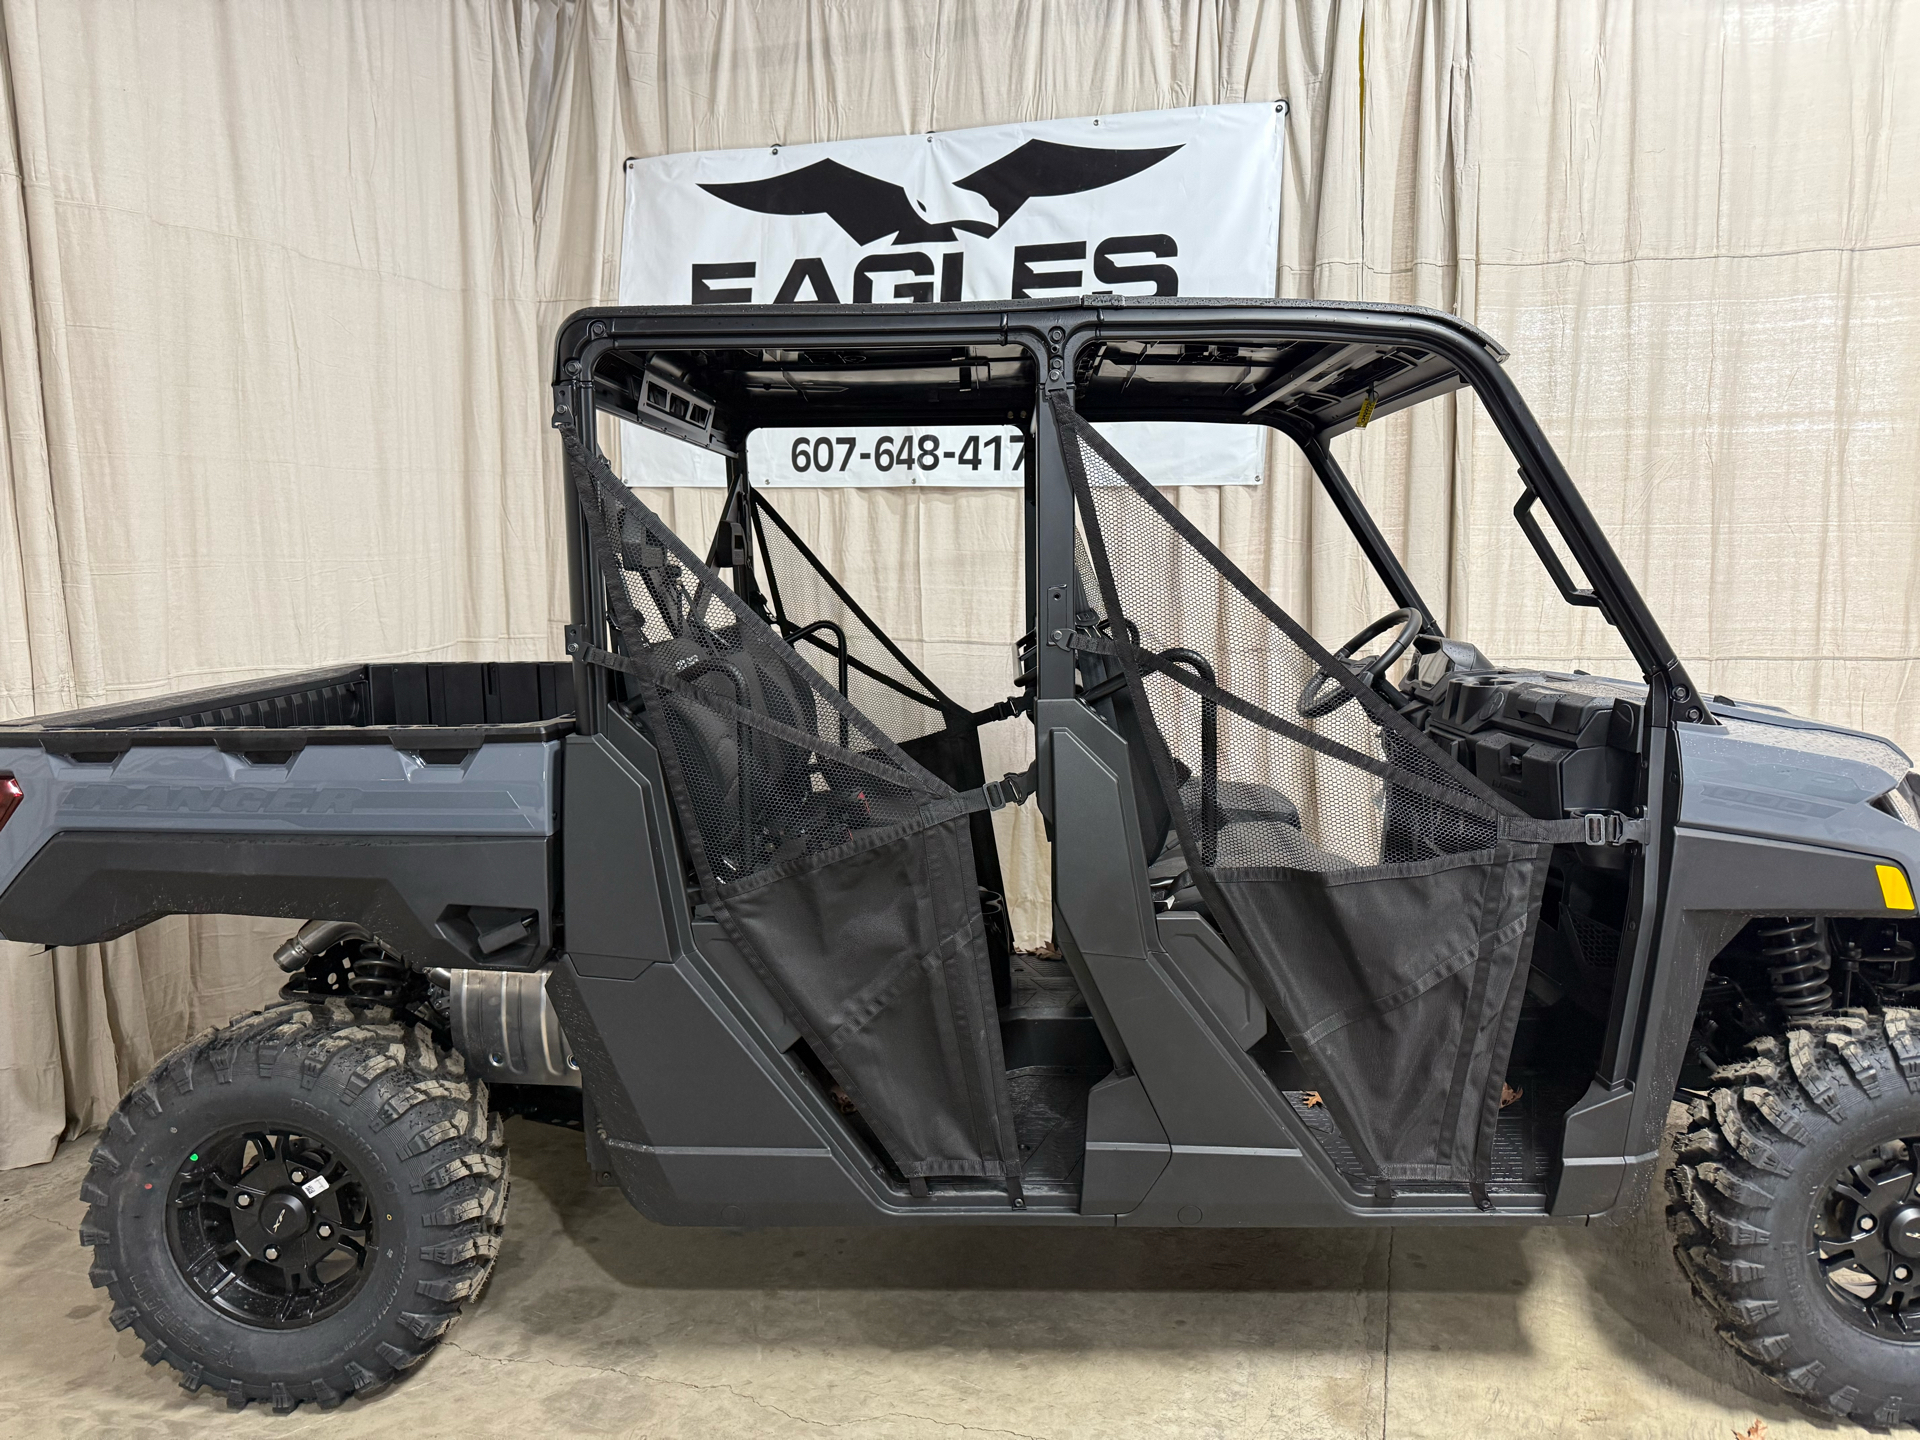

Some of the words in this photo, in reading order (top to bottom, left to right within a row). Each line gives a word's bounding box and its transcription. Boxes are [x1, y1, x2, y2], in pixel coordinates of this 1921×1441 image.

[691, 233, 1180, 306] EAGLES
[791, 434, 1025, 472] 607-648-417
[74, 784, 363, 814] RANGER
[128, 1268, 234, 1368] X-TERRAIN
